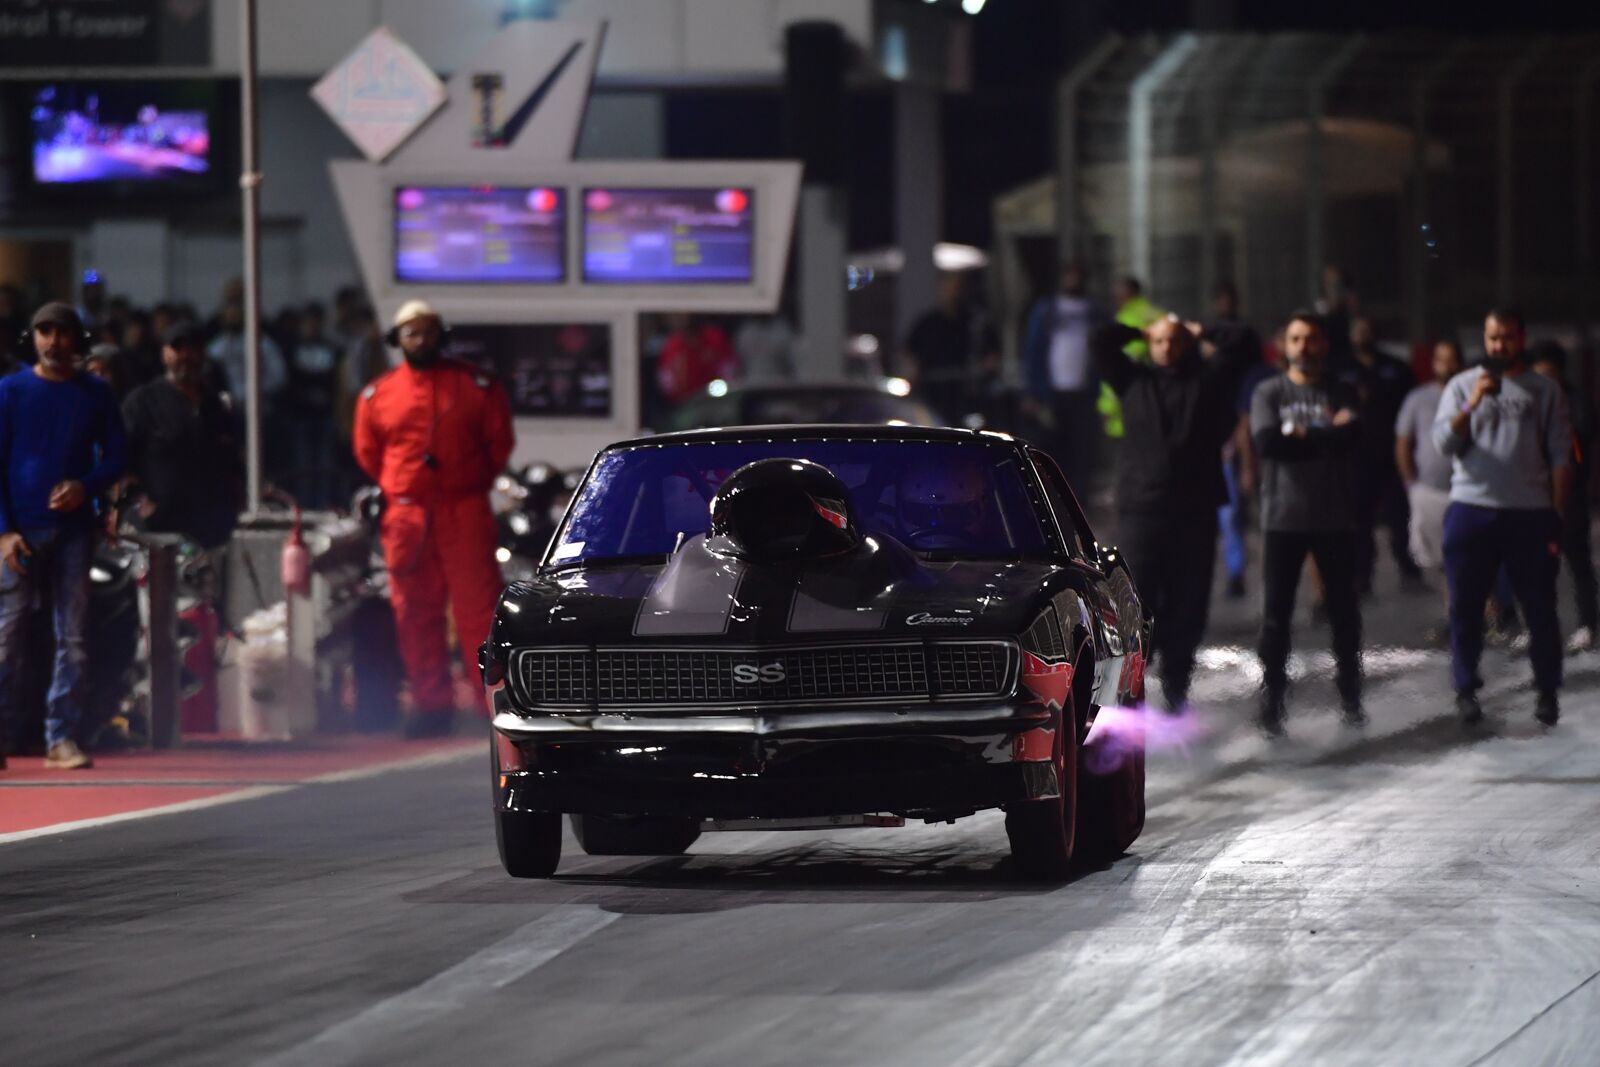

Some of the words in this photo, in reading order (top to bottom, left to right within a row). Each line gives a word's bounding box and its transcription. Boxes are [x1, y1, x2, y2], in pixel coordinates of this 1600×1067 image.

[56, 10, 148, 37] Tower
[905, 612, 974, 626] Camaro
[733, 662, 786, 684] SS
